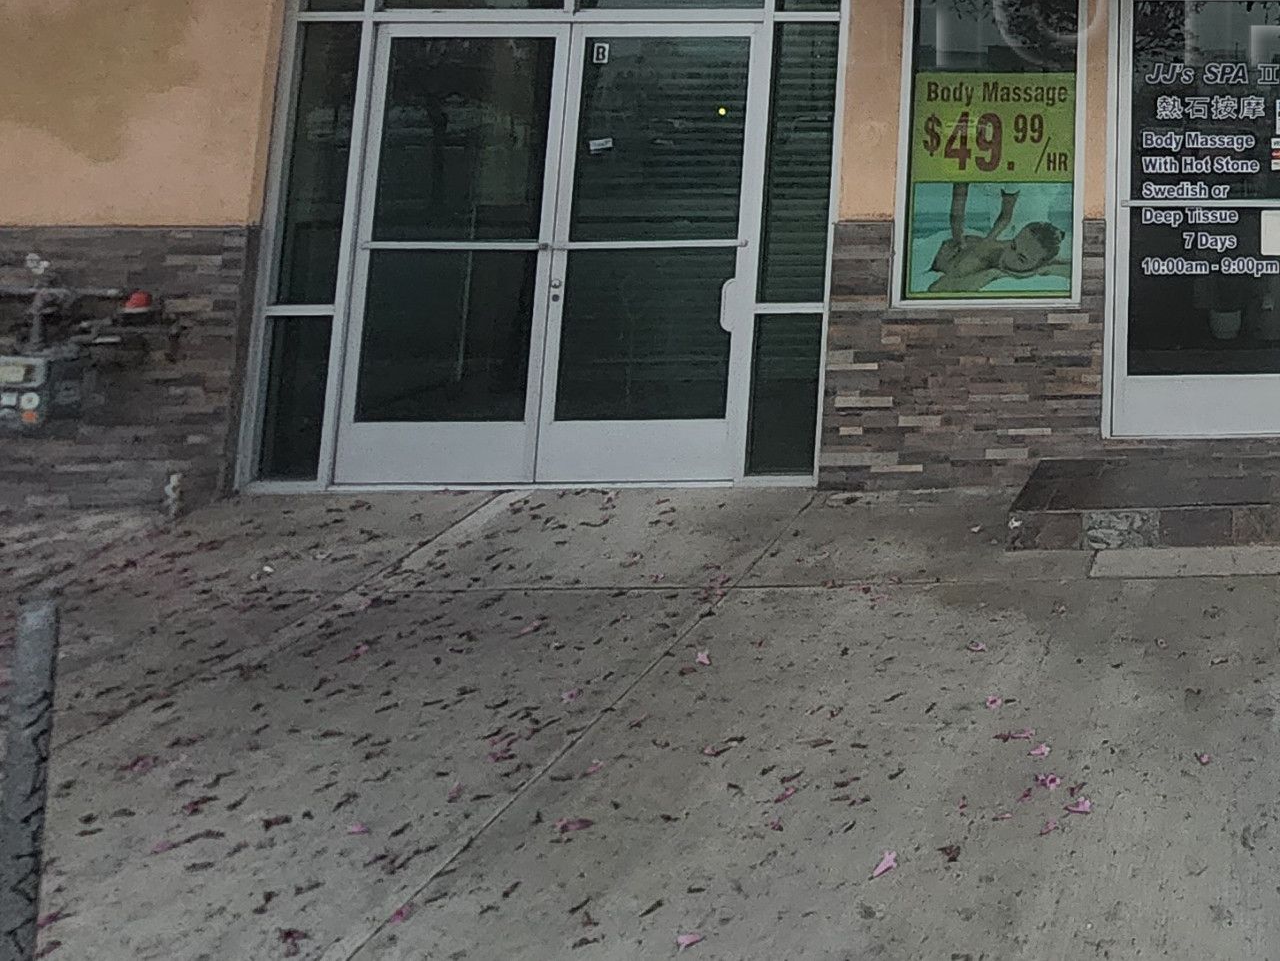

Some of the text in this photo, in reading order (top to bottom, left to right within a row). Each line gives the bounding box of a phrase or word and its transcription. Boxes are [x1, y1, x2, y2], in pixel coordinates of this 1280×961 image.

[1145, 63, 1280, 84] JJ's SPA II
[926, 81, 1069, 107] Body Massage
[1156, 95, 1266, 120] 熱石按摩
[1142, 131, 1256, 151] Body Massage
[1142, 156, 1260, 173] With Hot Stone
[1142, 181, 1230, 198] Swedish or
[1142, 207, 1239, 227] Deep Tissue
[1183, 233, 1238, 252] 7 Days
[1142, 257, 1210, 274] 10:00am
[1221, 258, 1280, 277] 9:00pm
